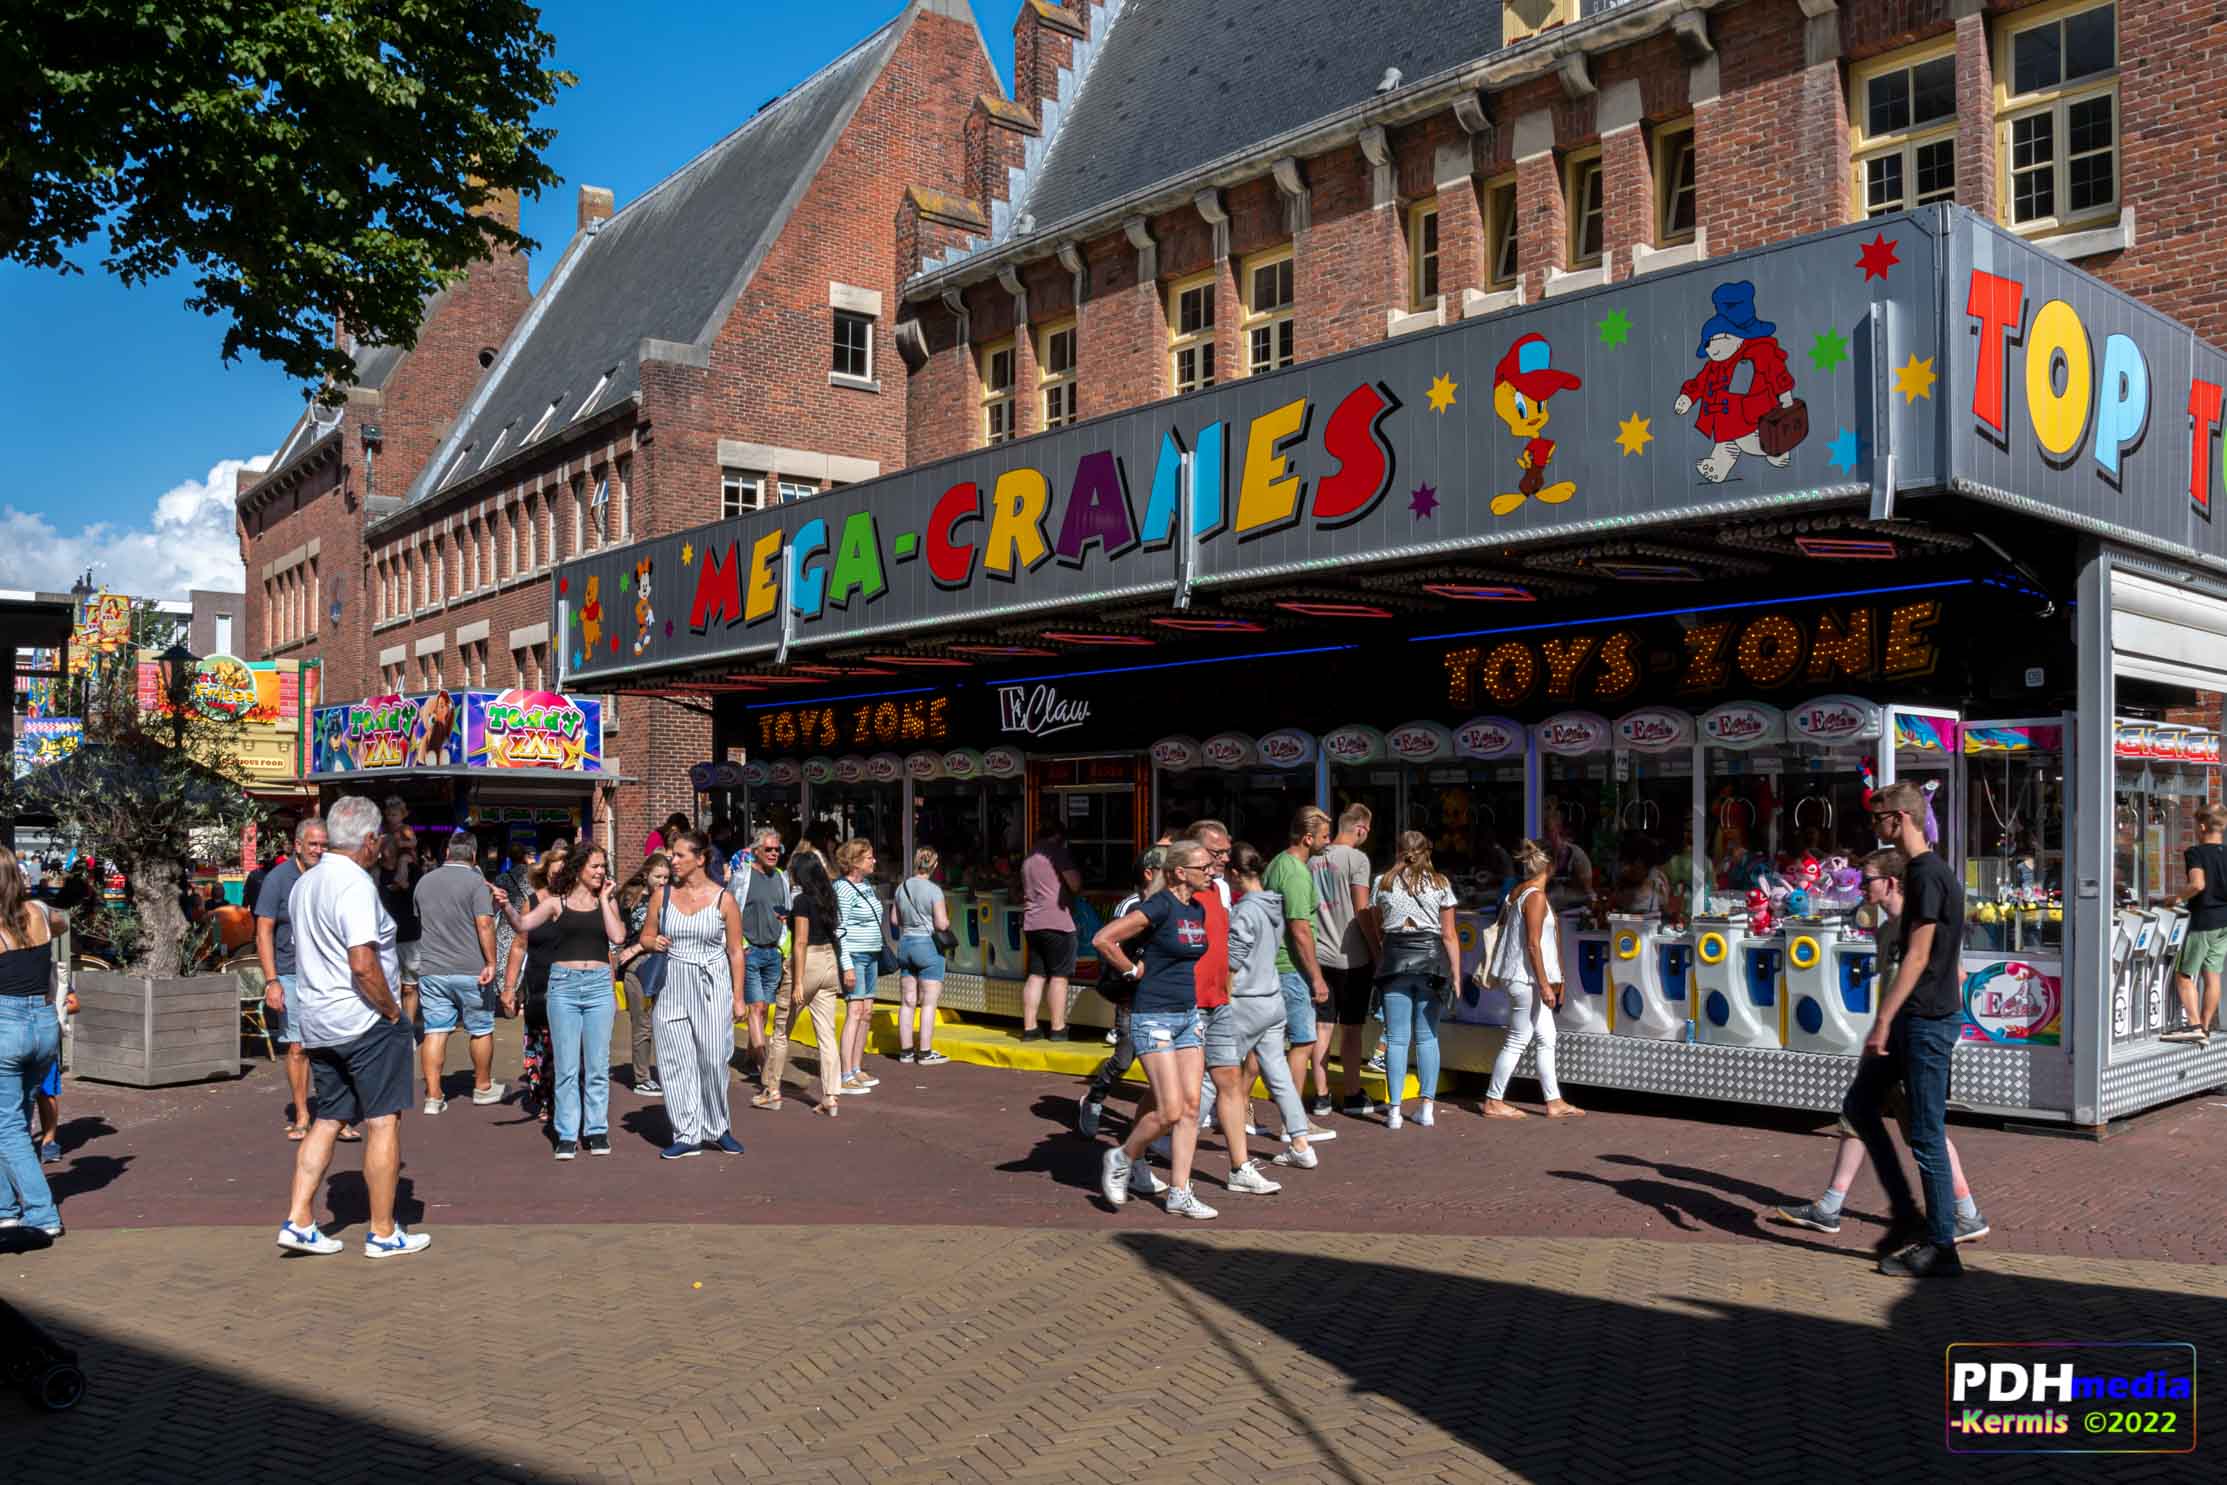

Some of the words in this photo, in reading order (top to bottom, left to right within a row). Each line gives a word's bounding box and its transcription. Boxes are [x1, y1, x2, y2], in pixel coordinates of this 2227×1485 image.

[1966, 269, 2150, 490] TOP
[2188, 378, 2227, 523] T
[690, 382, 1397, 634] MEGA-CRANES
[1444, 631, 1637, 702] TOYS
[1684, 600, 1938, 690] ZONE
[487, 704, 582, 738] Teddy
[508, 730, 562, 760] XXL
[759, 708, 837, 748] TOYS
[853, 696, 947, 743] ZONE
[364, 731, 402, 767] XXL
